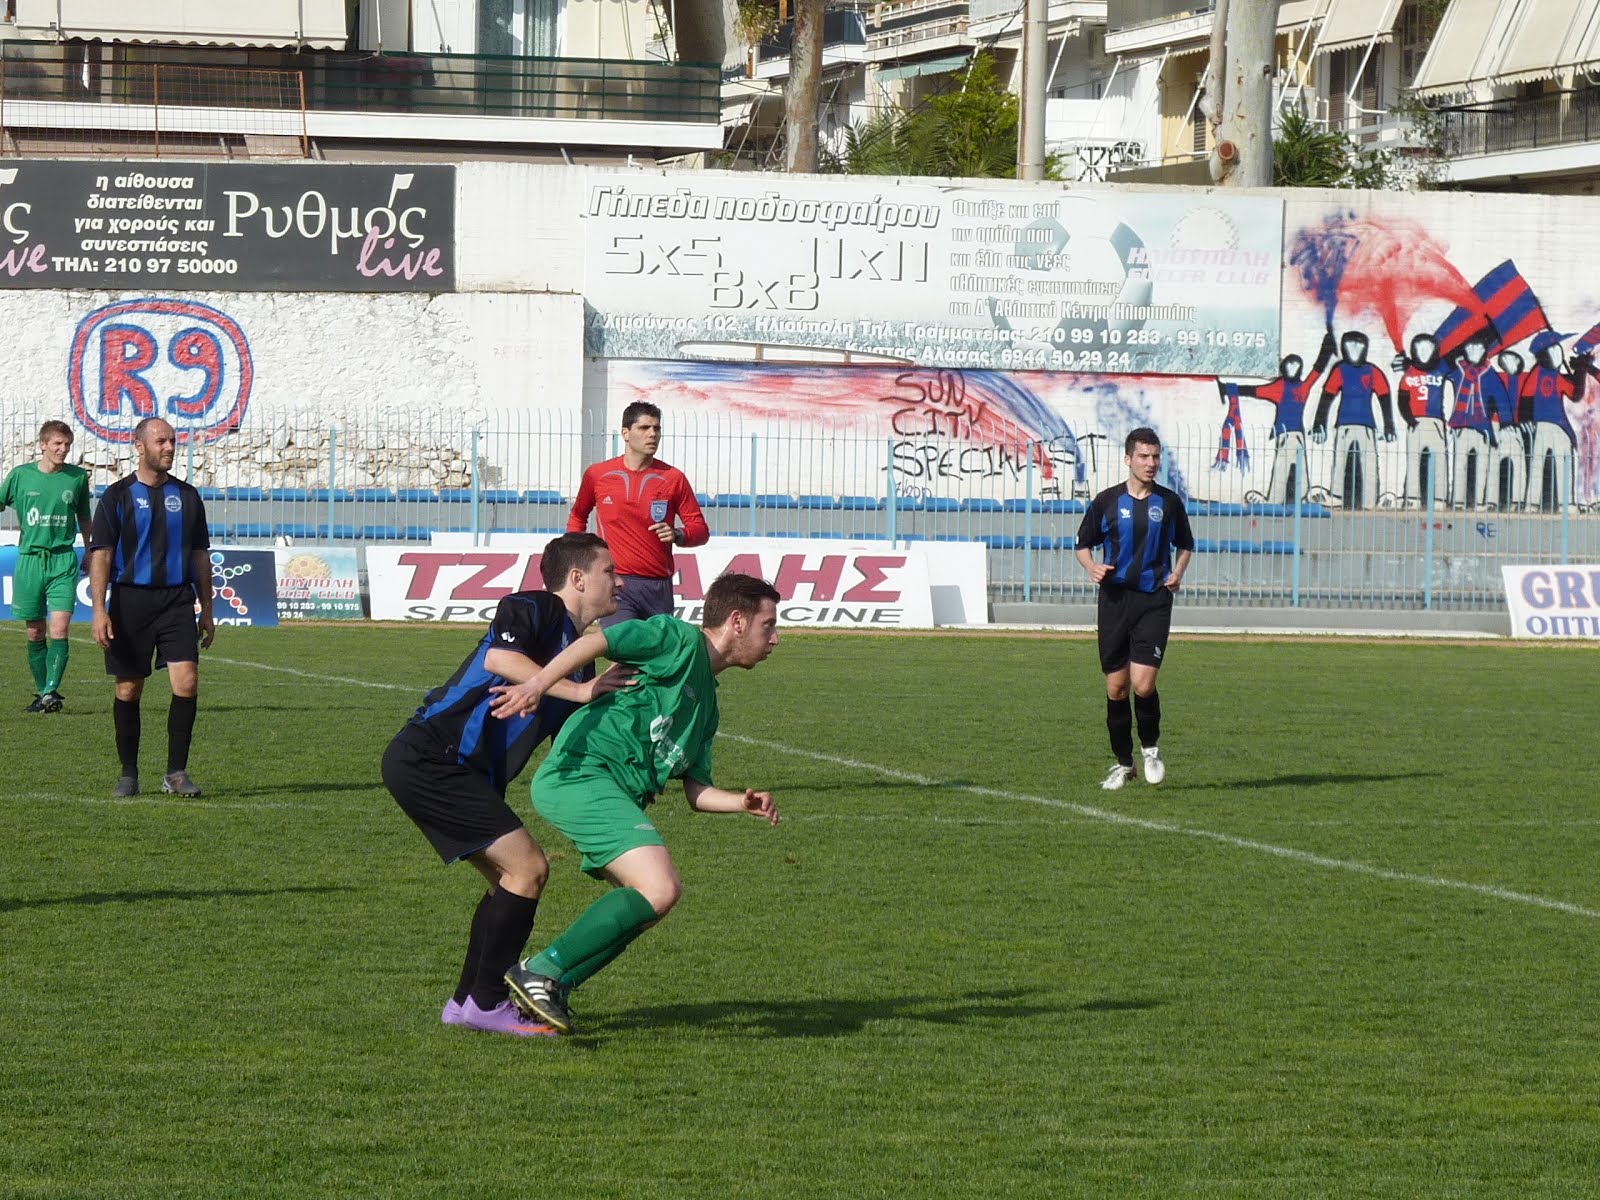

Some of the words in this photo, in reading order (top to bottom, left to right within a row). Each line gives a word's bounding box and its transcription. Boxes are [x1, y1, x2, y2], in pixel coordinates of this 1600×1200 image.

[96, 175, 109, 191] η
[115, 173, 194, 189] αίθουσα
[87, 194, 203, 210] διατείθενται
[588, 185, 709, 219] Γήπεδα
[714, 191, 940, 232] ποδοσφαίρου
[953, 199, 1005, 219] Φτιάξε
[1009, 204, 1029, 218] και
[1033, 201, 1060, 218] εσύ
[223, 173, 427, 255] Ρυθμός
[74, 217, 103, 233] για
[108, 215, 180, 234] χορούς
[184, 219, 215, 232] και
[952, 228, 973, 242] την
[976, 225, 1021, 245] ομάδα
[1027, 227, 1054, 243] σου
[80, 236, 209, 256] συνεστιάσεις
[356, 226, 443, 281] live
[51, 256, 99, 272] ΤΗΛ:
[105, 258, 141, 273] 210
[146, 259, 172, 274] 97
[177, 258, 238, 274] 50000
[951, 253, 970, 267] και
[975, 249, 1002, 267] έλα
[1006, 254, 1032, 270] στις
[1037, 250, 1071, 272] νέες
[950, 274, 1024, 295] αθλητικές
[950, 301, 971, 316] στο
[995, 300, 1057, 319] Αθλητικό
[1062, 301, 1110, 322] Κέντρο
[1115, 302, 1197, 323] Ηλιούπολης
[704, 315, 736, 331] 102
[1031, 328, 1065, 343] 210
[1071, 329, 1094, 344] 99
[1100, 330, 1122, 344] 10
[1126, 330, 1160, 345] 283
[1178, 330, 1200, 345] 99
[1206, 331, 1228, 346] 10
[1233, 332, 1266, 347] 975
[1001, 349, 1046, 365] 6944
[1108, 352, 1130, 366] 24
[99, 322, 224, 419] R9
[1405, 374, 1443, 387] REBELS
[1417, 385, 1429, 400] 9
[321, 602, 332, 610] 99
[345, 603, 359, 611] 975
